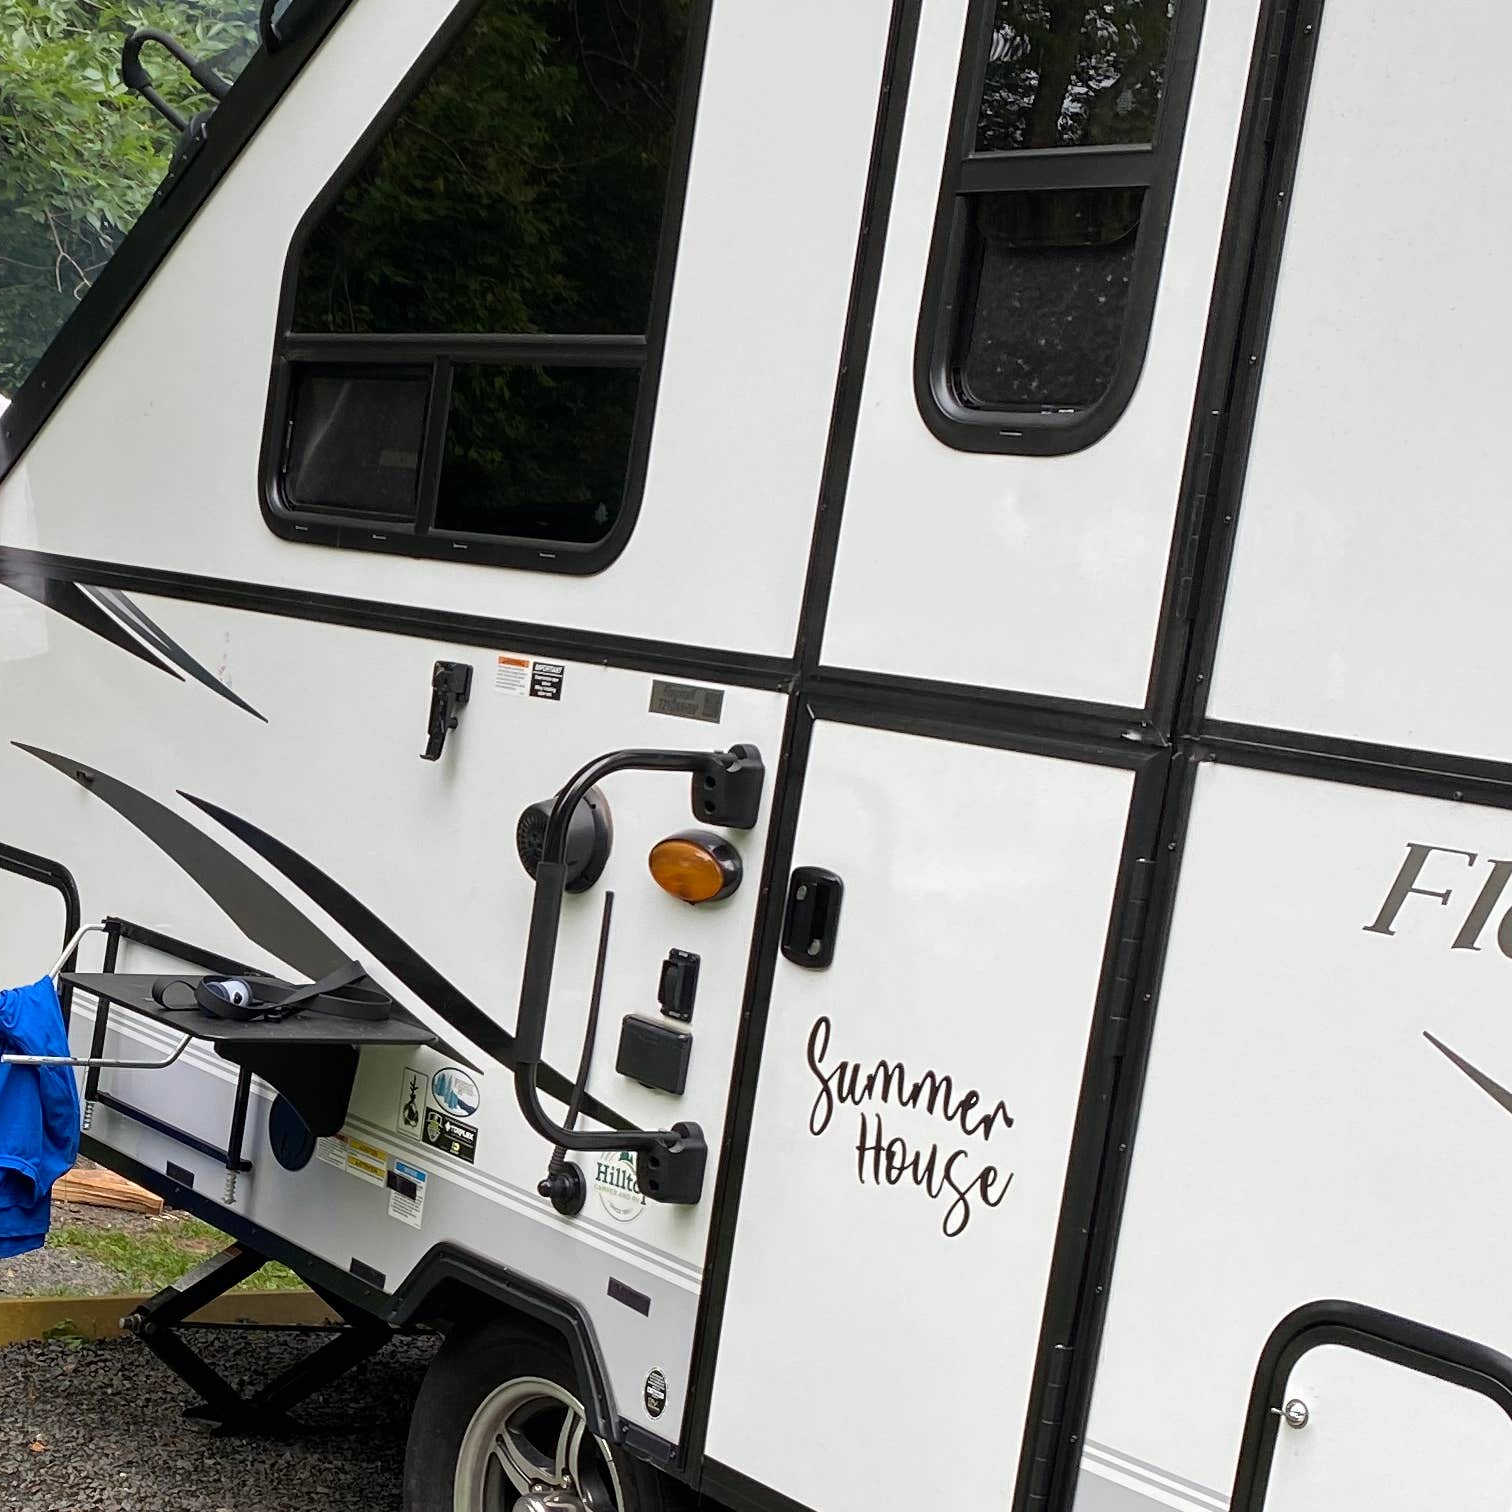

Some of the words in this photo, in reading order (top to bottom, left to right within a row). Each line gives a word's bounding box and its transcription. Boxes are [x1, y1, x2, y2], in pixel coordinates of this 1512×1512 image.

[1362, 842, 1512, 960] Fl
[806, 1015, 1015, 1141] Summer
[855, 1112, 1015, 1238] House
